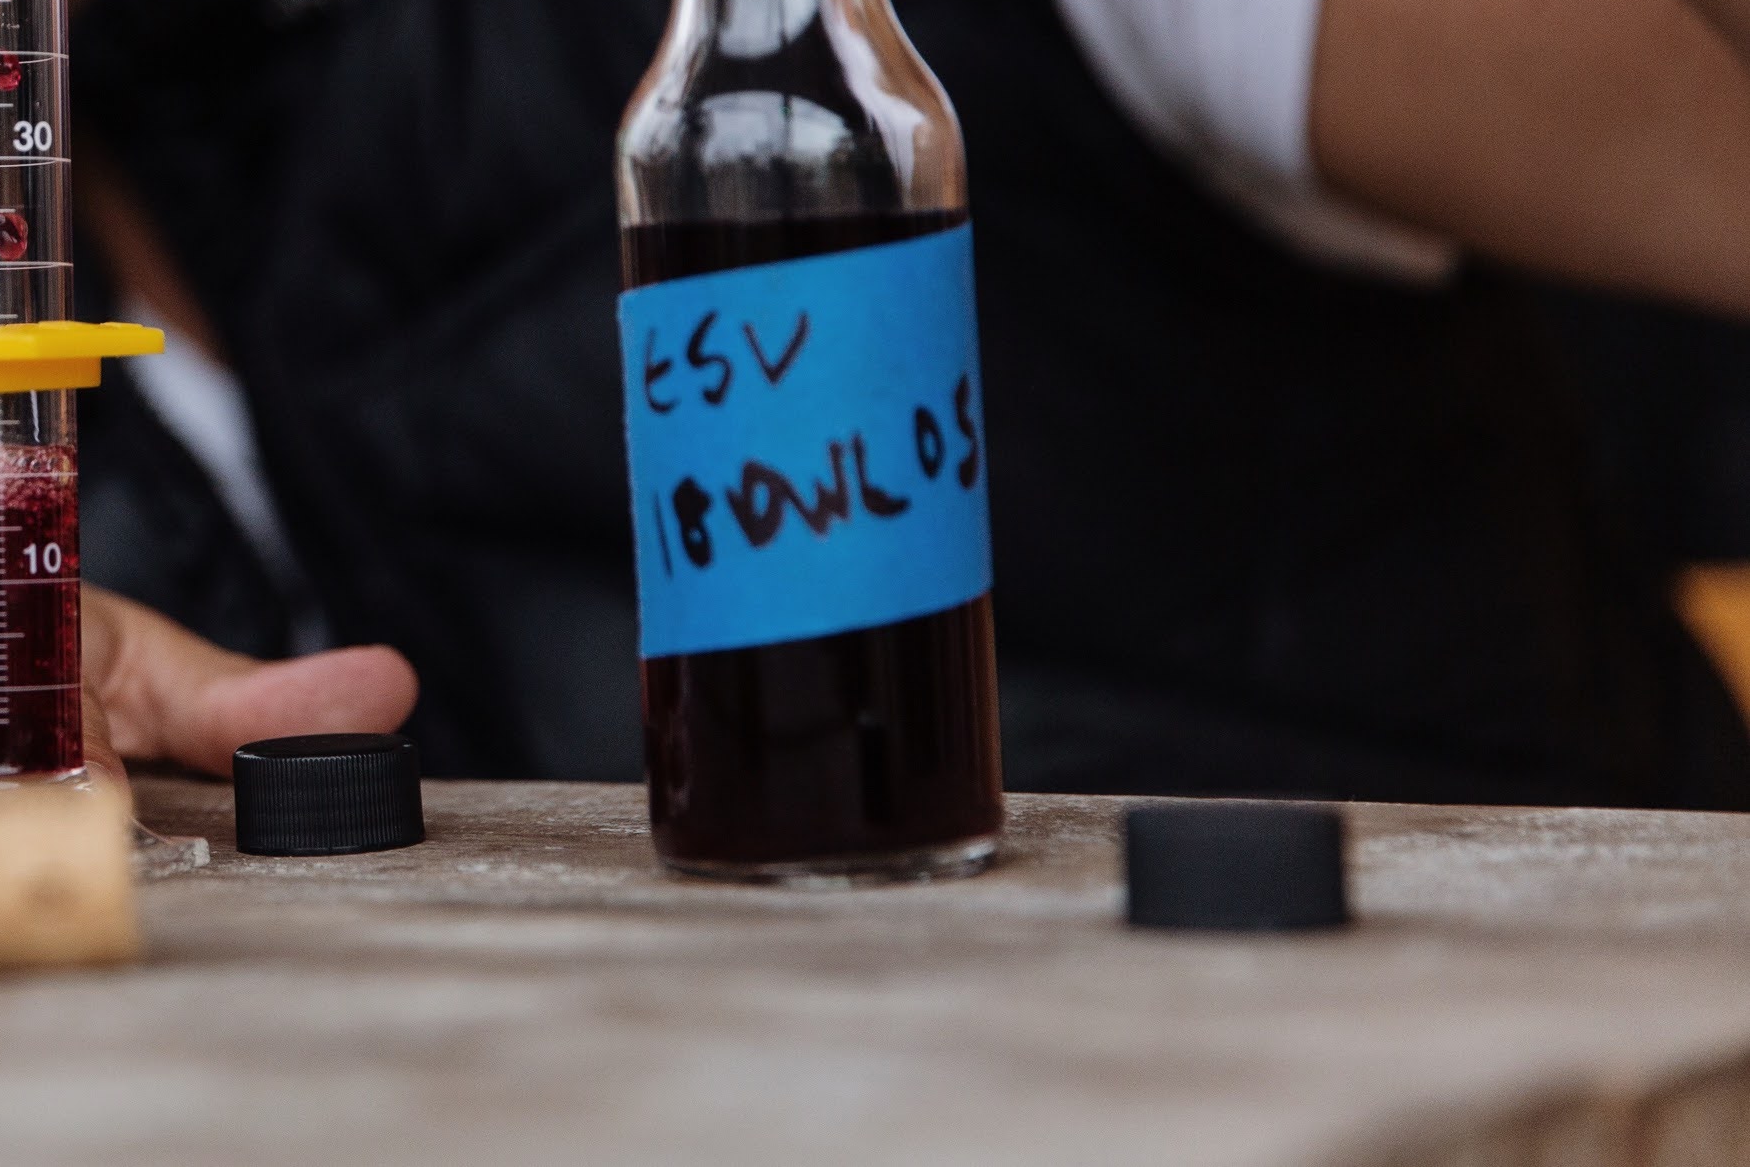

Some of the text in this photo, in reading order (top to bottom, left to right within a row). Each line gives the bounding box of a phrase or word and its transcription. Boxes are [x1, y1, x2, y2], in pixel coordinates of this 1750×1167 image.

[12, 120, 52, 152] 30
[644, 306, 810, 415] ESV
[22, 541, 63, 575] 10
